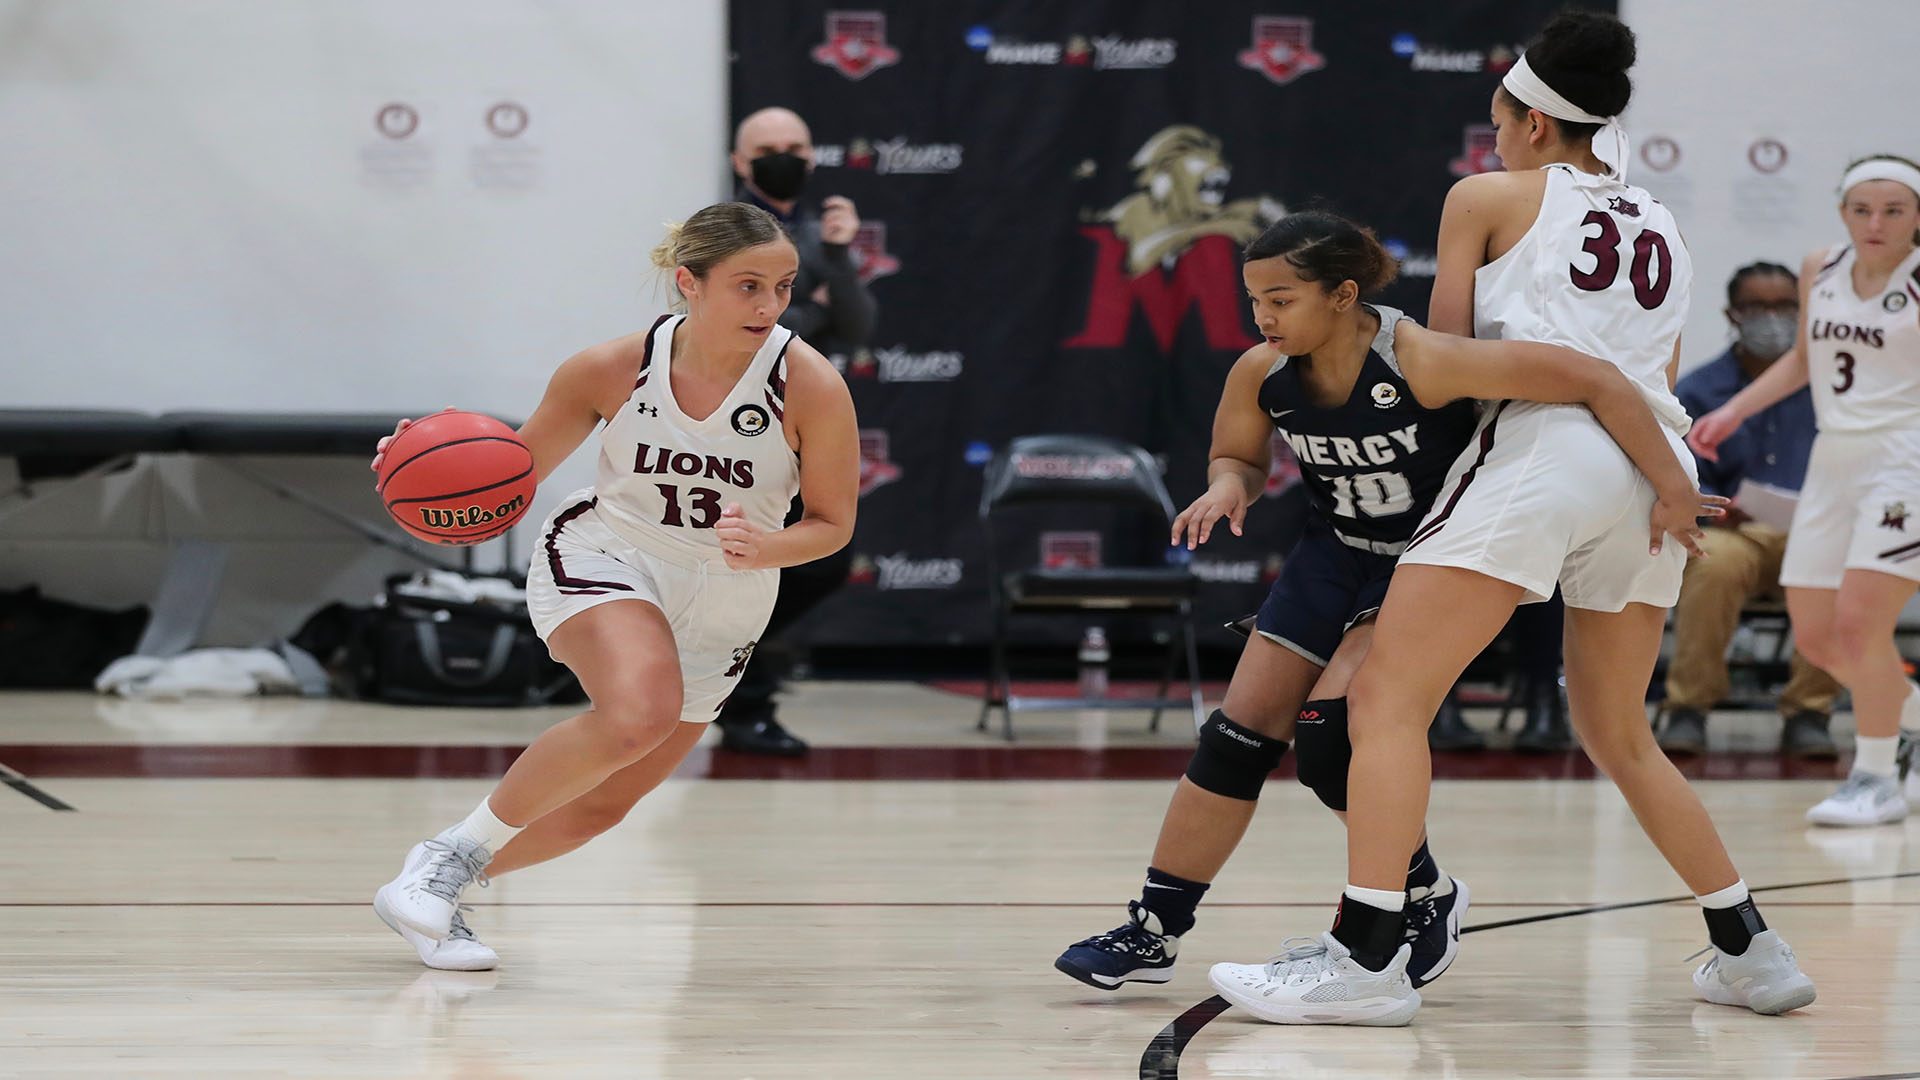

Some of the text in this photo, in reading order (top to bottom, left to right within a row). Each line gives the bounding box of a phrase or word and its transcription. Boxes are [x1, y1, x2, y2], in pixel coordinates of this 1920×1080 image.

[1091, 35, 1177, 70] YOURS
[873, 136, 963, 175] YOURS
[1569, 209, 1673, 311] 30
[1812, 319, 1884, 348] LIONS
[874, 344, 964, 383] YOURS
[1831, 351, 1856, 394] 3
[1277, 422, 1420, 466] MERCY
[633, 442, 755, 489] LIONS
[419, 493, 525, 529] Wilson
[654, 483, 723, 529] 13
[1317, 471, 1416, 520] 10
[874, 550, 963, 590] YOURS
